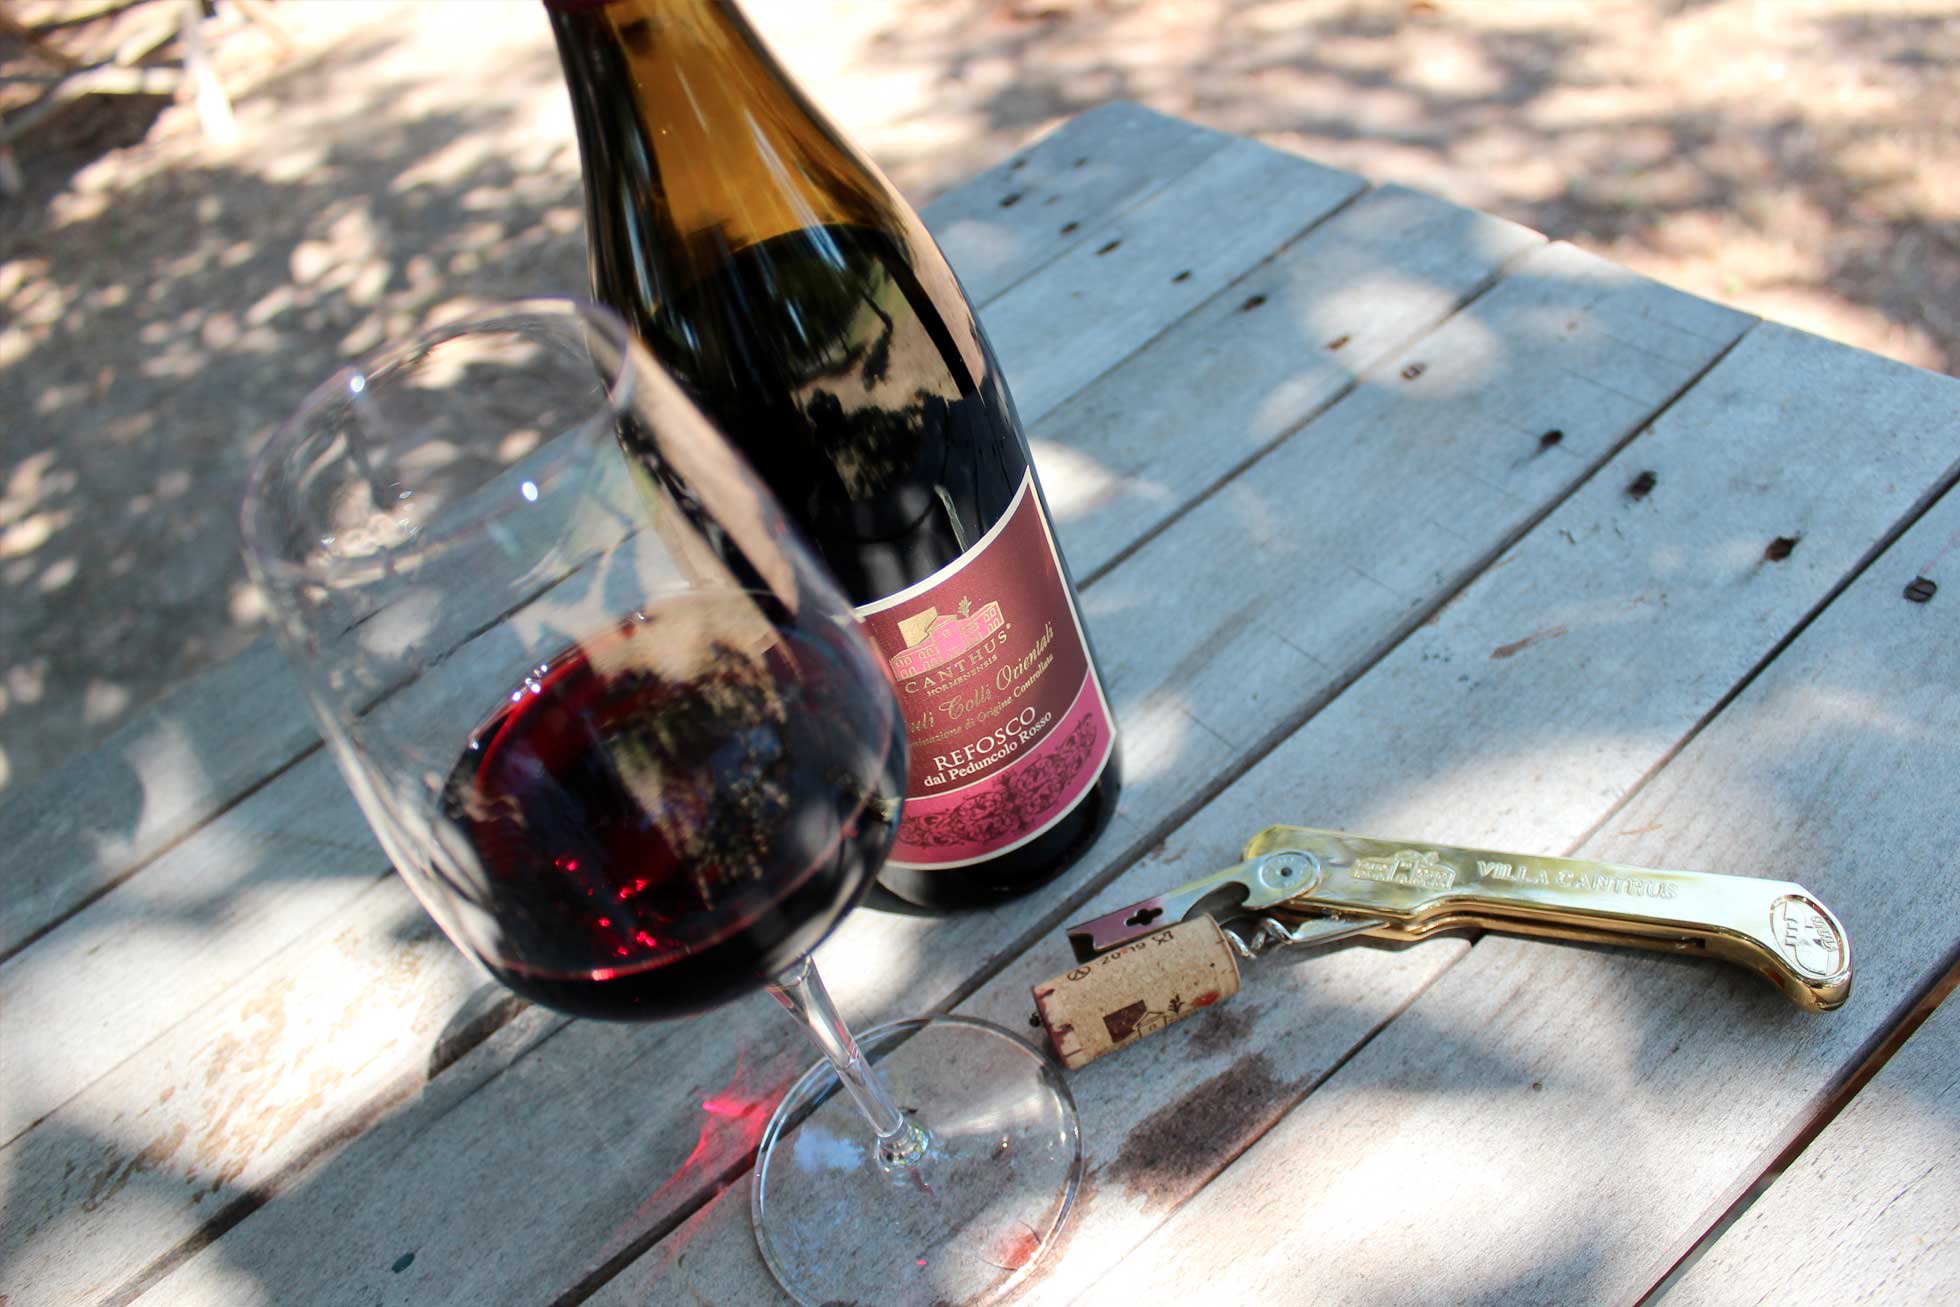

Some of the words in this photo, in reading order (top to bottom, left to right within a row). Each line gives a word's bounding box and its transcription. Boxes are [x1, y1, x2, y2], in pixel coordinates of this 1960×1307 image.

[904, 630, 1007, 694] CANTHUS
[938, 683, 992, 720] Colli
[996, 620, 1054, 691] Orientali
[924, 772, 947, 787] dal
[949, 741, 1018, 781] Peduncolo
[1018, 711, 1052, 744] Rosso
[933, 706, 1036, 772] REFOSCO
[1477, 860, 1549, 886] VILLA
[1555, 869, 1680, 899] CANTHUS
